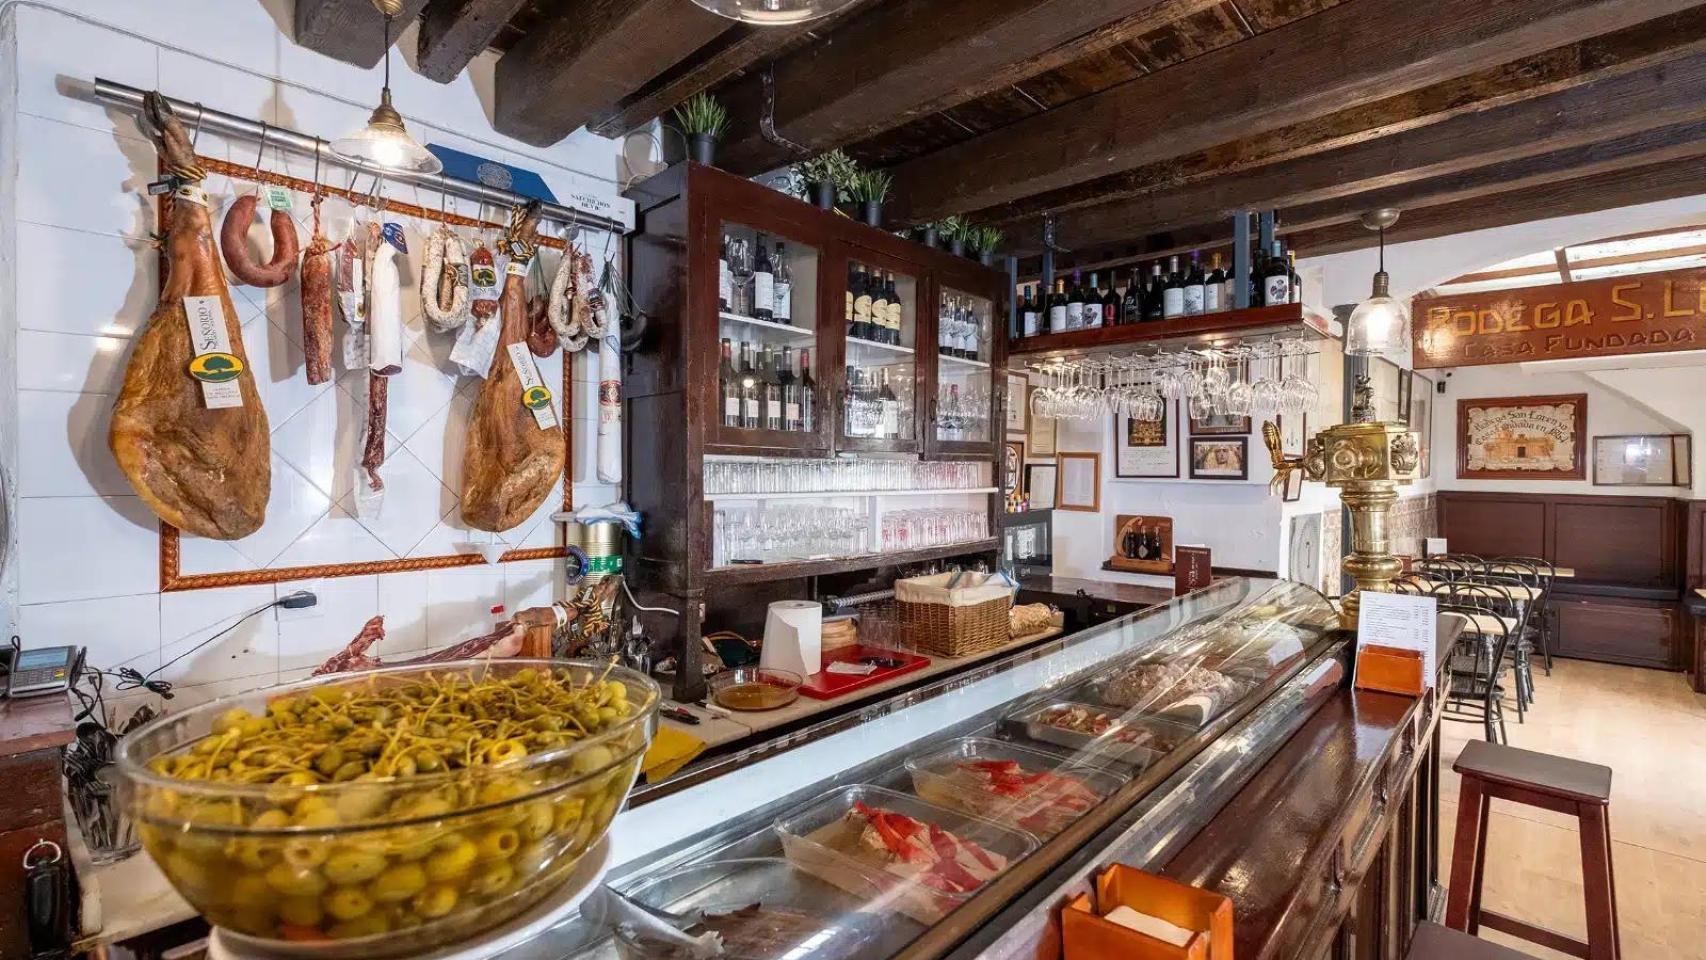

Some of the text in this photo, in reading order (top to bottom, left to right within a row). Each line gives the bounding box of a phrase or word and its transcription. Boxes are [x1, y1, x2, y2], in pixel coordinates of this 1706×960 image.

[1427, 299, 1595, 336] BODEGA
[1464, 328, 1696, 358] CASA FUNDADA
[1508, 410, 1527, 419] San
